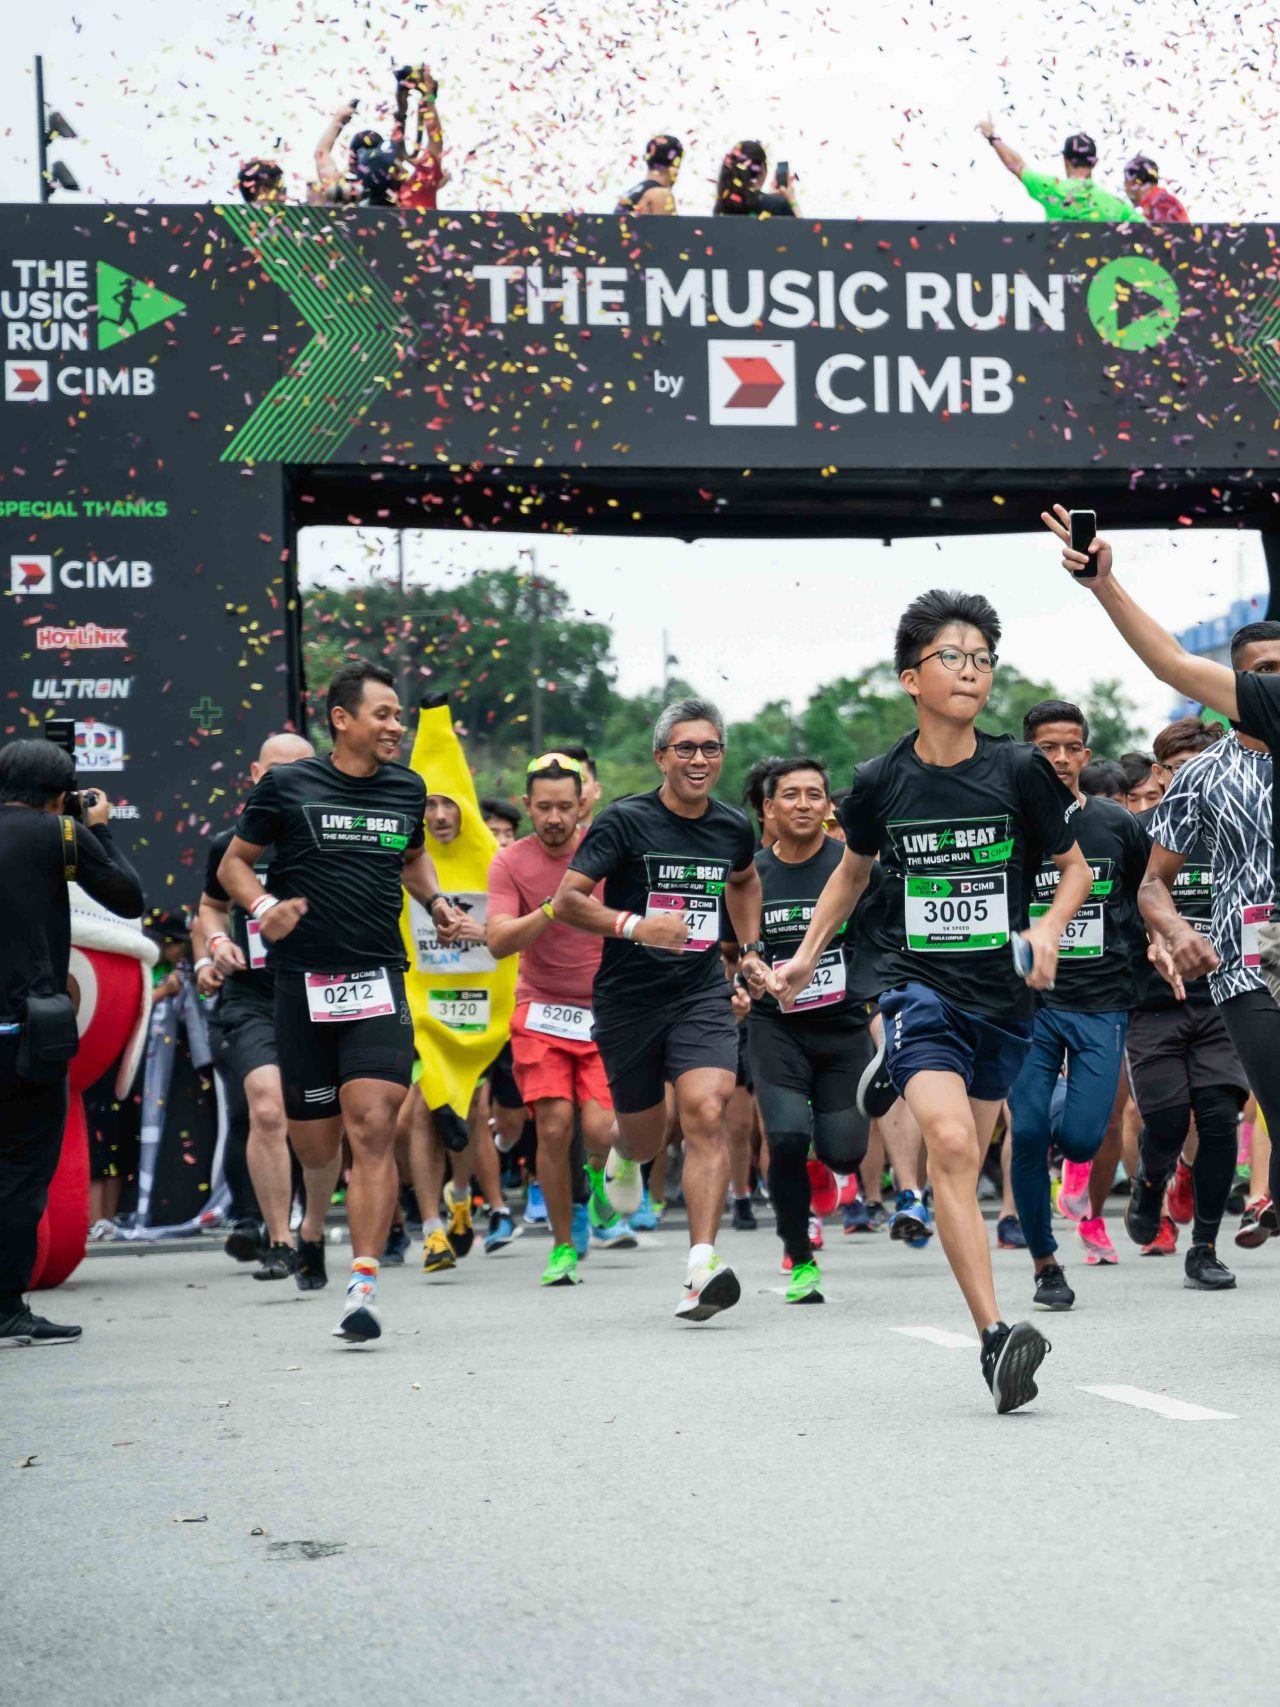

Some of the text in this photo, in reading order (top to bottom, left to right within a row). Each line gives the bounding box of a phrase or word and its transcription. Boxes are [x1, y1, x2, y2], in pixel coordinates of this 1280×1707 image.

[12, 260, 87, 288] THE
[0, 291, 88, 319] USIC
[472, 265, 630, 325] THE
[645, 268, 890, 329] MUSIC
[906, 271, 1066, 331] RUN
[8, 322, 88, 351] RUN
[57, 366, 155, 396] CIMB
[654, 353, 1014, 414] by CIMB
[0, 501, 168, 517] SPECIAL THANKS
[59, 560, 153, 588] CIMB
[32, 678, 130, 699] ULTRON
[321, 815, 352, 829] LIVE
[366, 818, 399, 833] BEAT
[361, 834, 378, 842] RUN
[903, 833, 938, 853] LIVE
[954, 827, 997, 848] BEAT
[907, 857, 922, 866] THE
[923, 854, 950, 864] MUSIC
[952, 852, 970, 861] RUN
[659, 865, 684, 879] LIVE
[696, 866, 724, 880] BEAT
[1035, 870, 1060, 886] LIVE
[973, 882, 995, 891] CIMB
[765, 908, 789, 924] LIVE
[924, 899, 988, 923] 3005
[676, 912, 707, 930] 47
[778, 925, 798, 933] MUSIC
[1064, 922, 1088, 938] 67
[421, 953, 461, 965] PLAN
[810, 969, 832, 988] 42
[324, 984, 374, 1004] 0212
[439, 1002, 477, 1017] 3120
[542, 1004, 583, 1024] 6206
